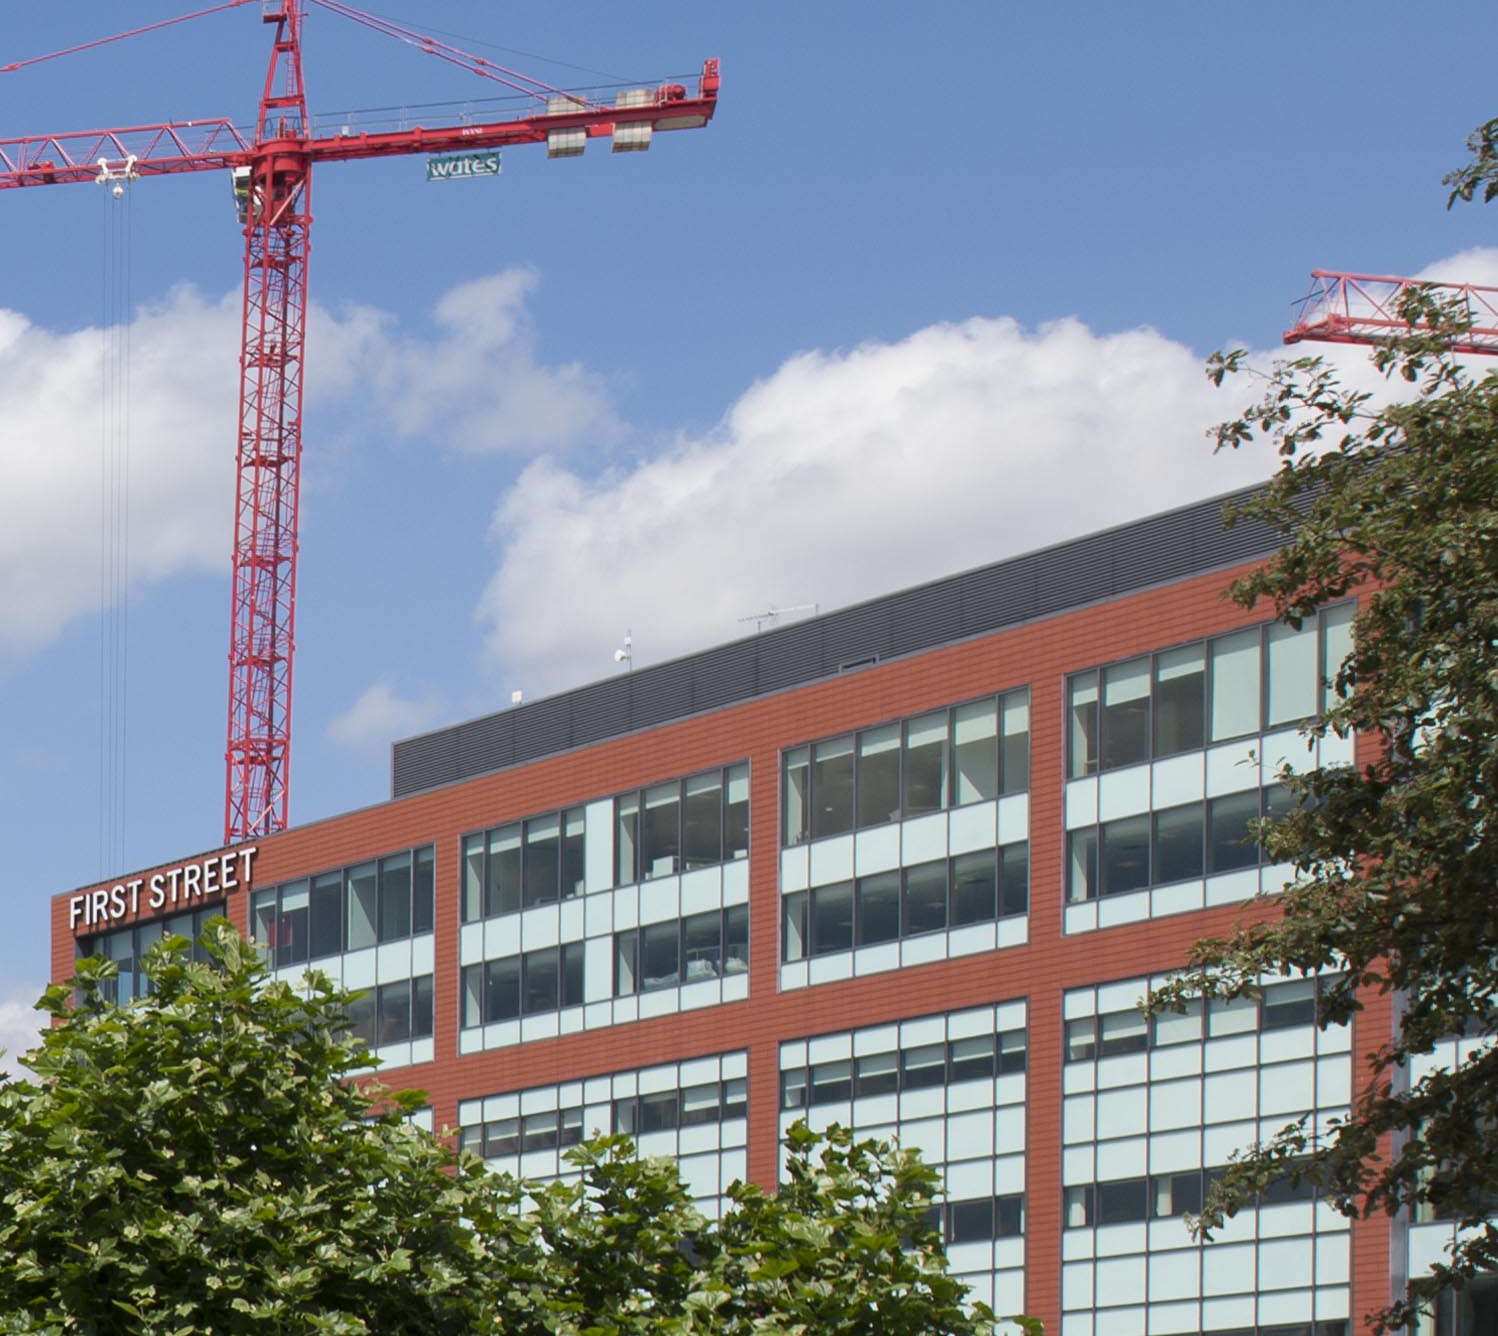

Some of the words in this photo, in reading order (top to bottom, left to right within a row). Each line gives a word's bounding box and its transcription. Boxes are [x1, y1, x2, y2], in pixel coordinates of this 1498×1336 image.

[429, 157, 498, 177] wates
[69, 879, 143, 930] FIRST
[148, 847, 257, 908] STREET
